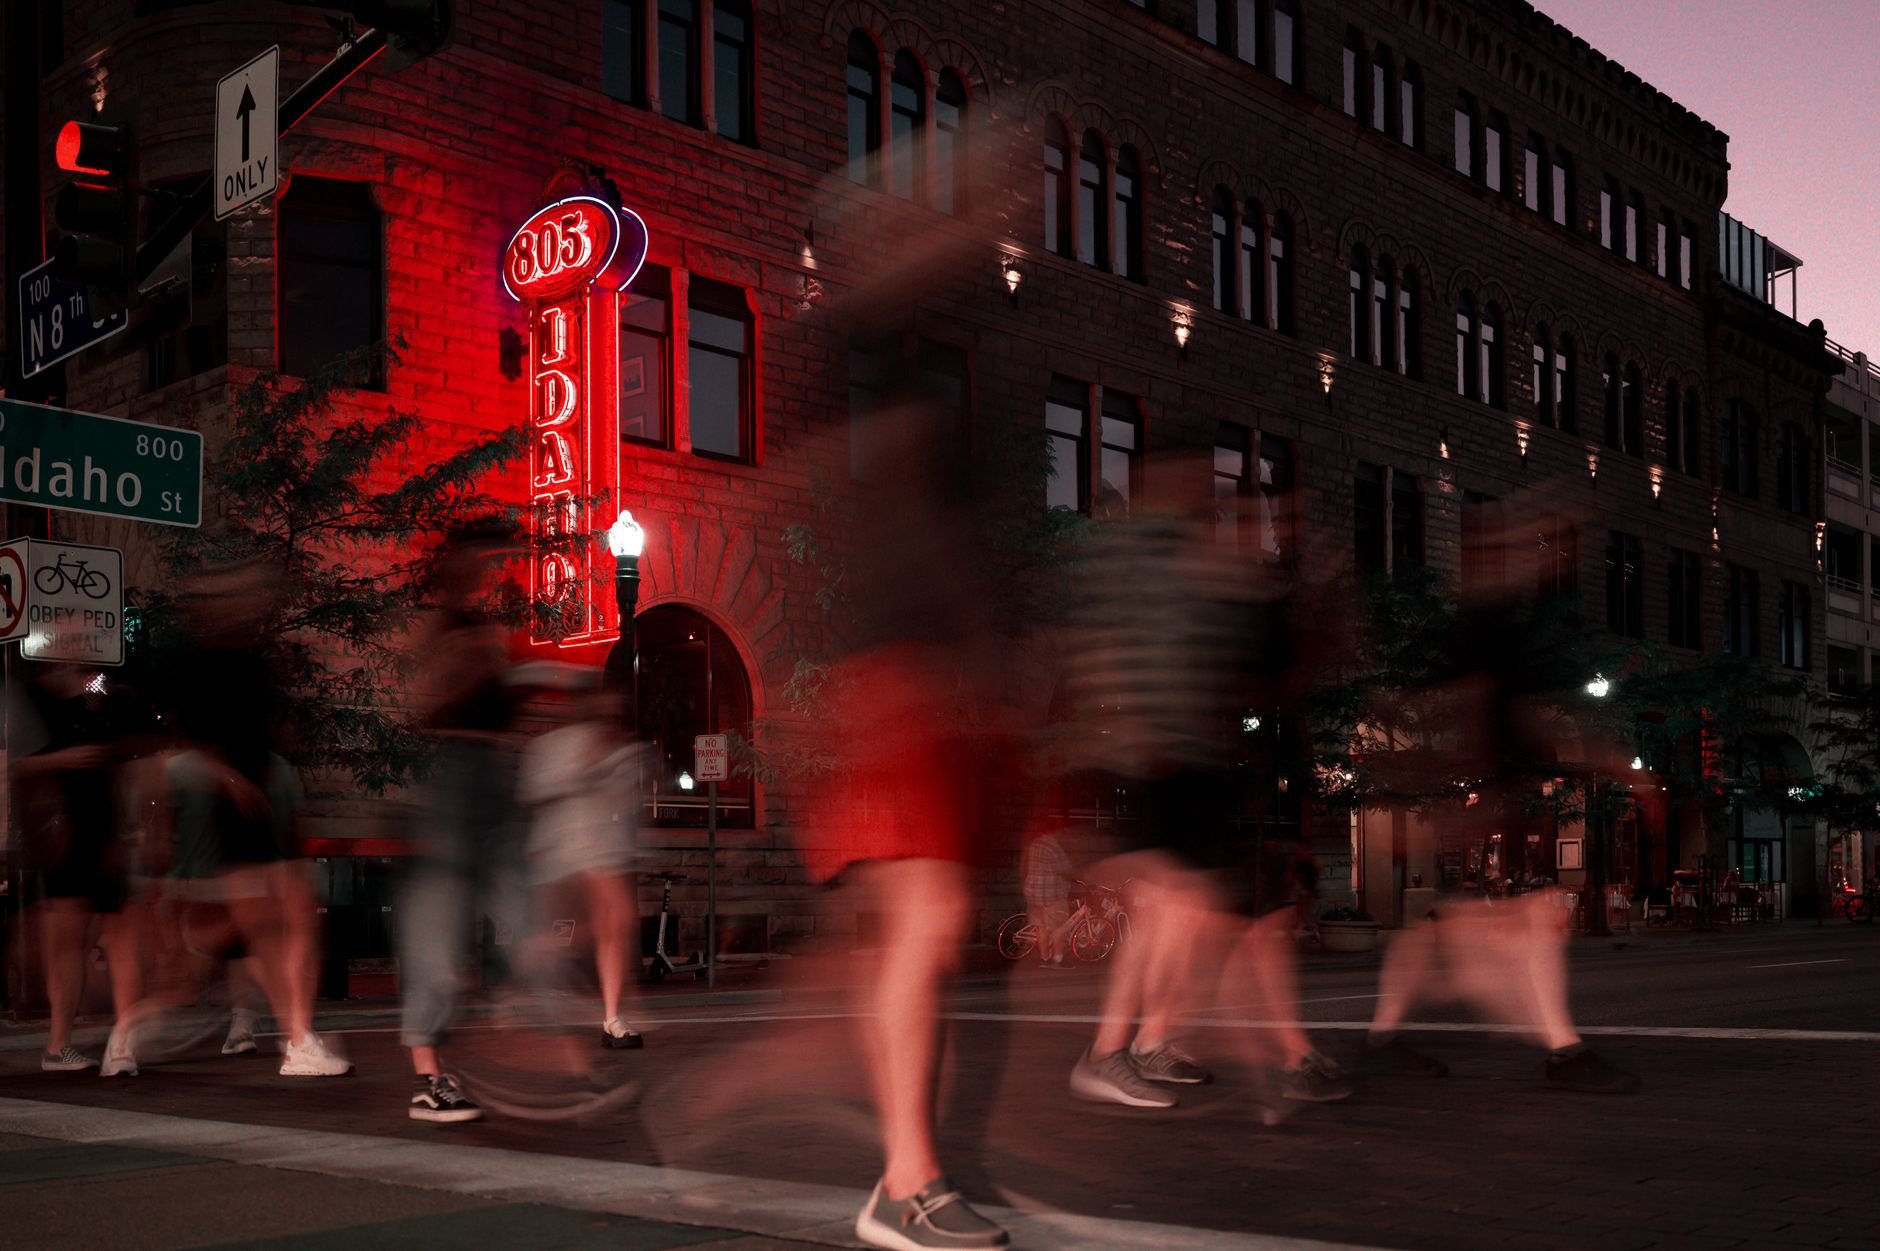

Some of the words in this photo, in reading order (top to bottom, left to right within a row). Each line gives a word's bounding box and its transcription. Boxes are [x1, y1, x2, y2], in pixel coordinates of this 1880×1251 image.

[224, 155, 268, 201] ONLY
[512, 210, 588, 285] 805
[29, 274, 50, 306] 100
[30, 311, 44, 362] N
[136, 434, 184, 462] 800
[160, 490, 183, 514] St
[30, 604, 75, 624] OBEY
[84, 609, 116, 629] PED
[698, 748, 724, 758] PARKING
[705, 739, 717, 748] NO
[659, 807, 680, 820] FORK
